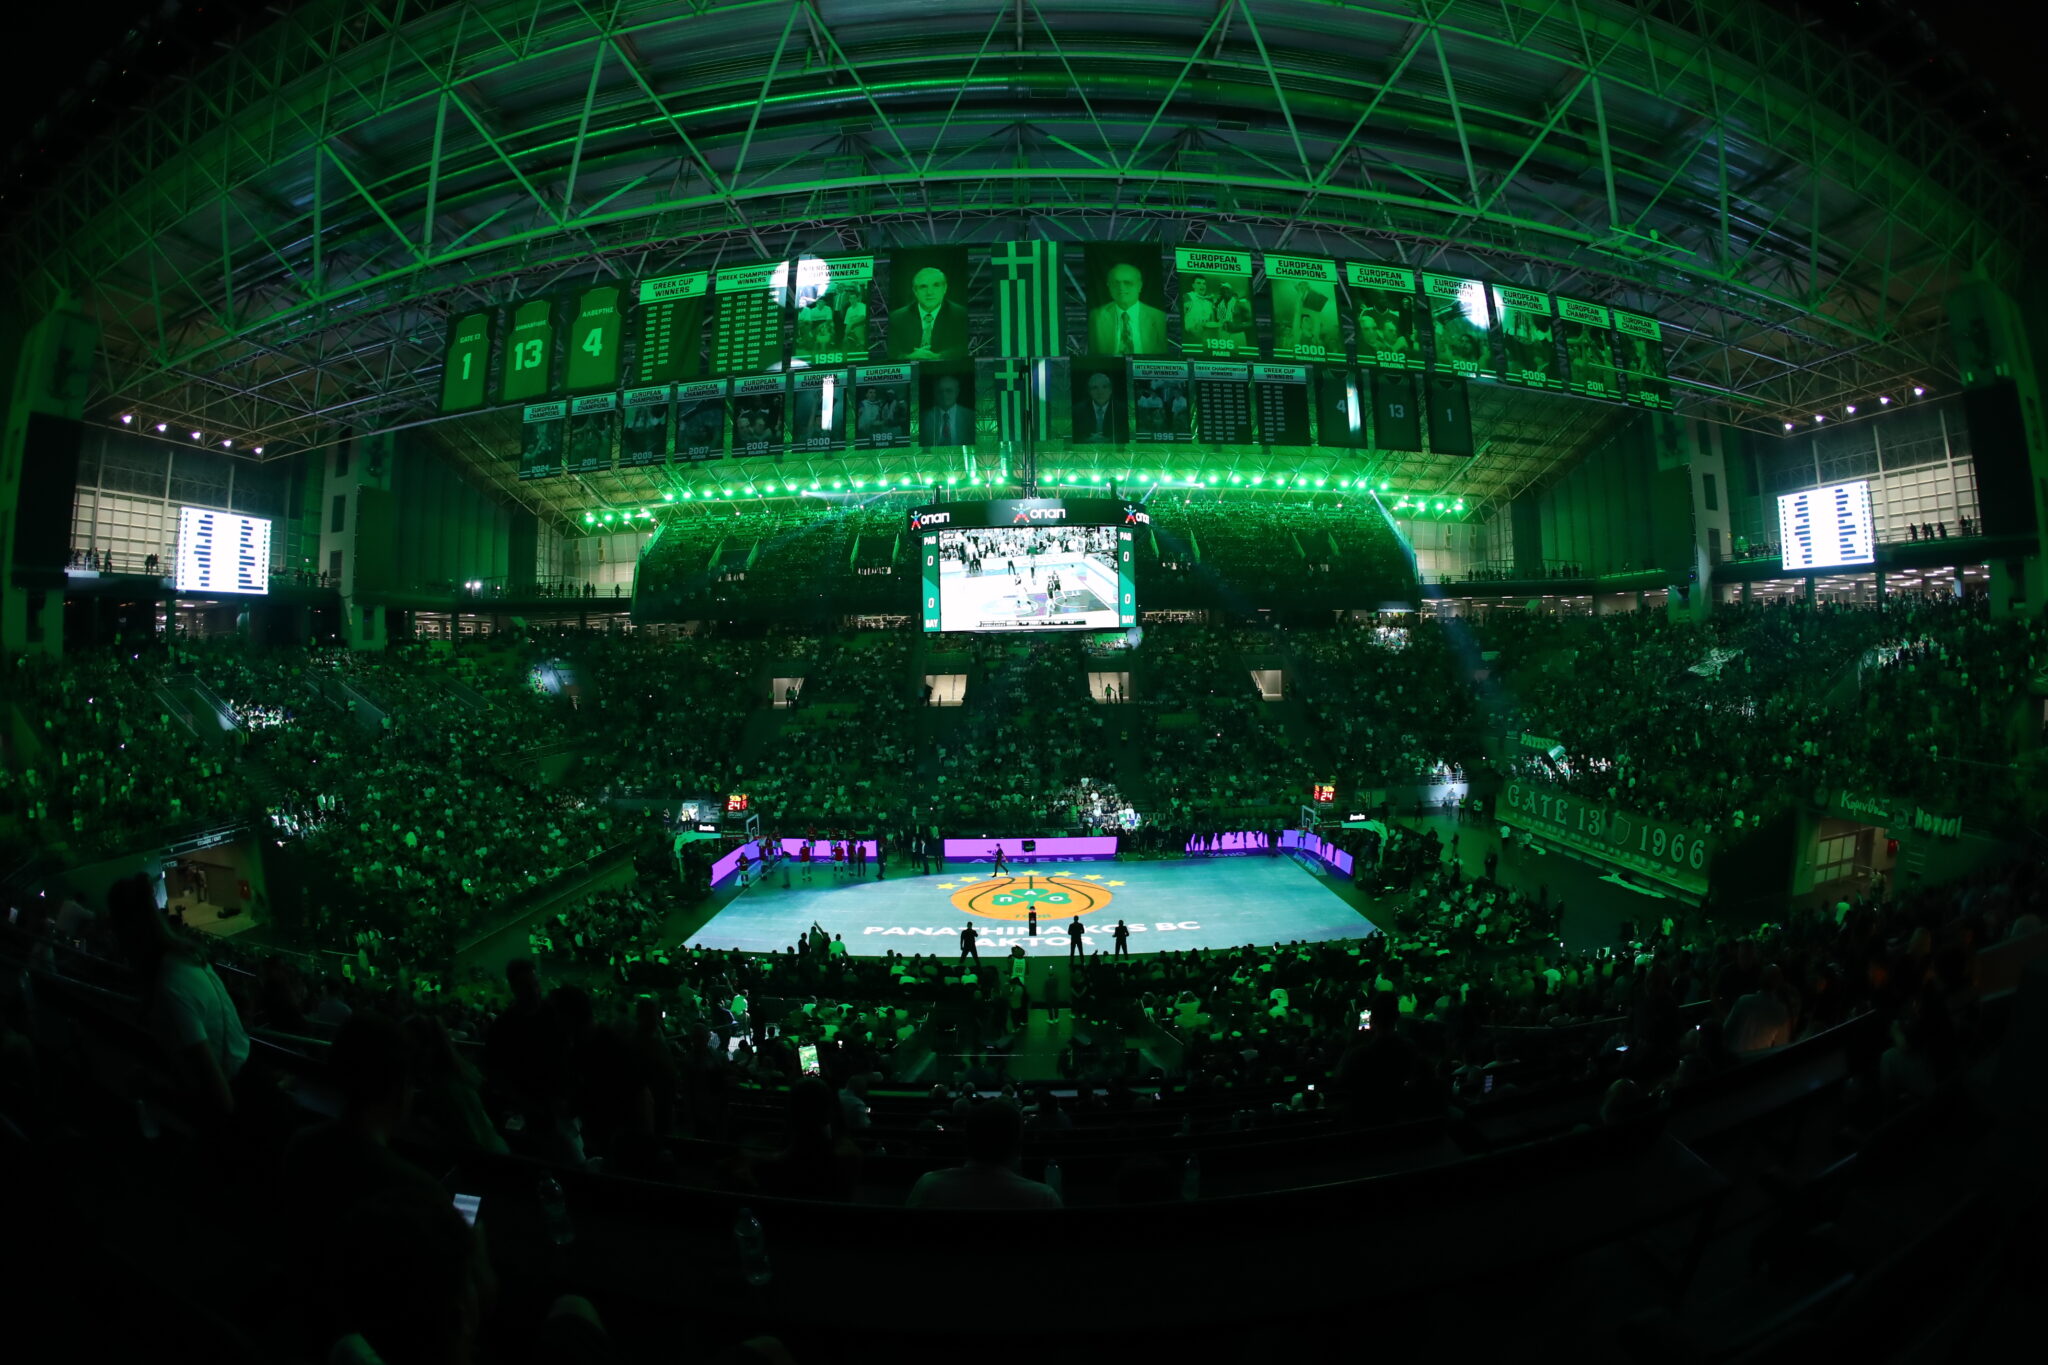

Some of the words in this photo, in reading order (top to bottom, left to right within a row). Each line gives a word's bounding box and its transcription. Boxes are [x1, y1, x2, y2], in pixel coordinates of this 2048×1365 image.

[1190, 253, 1238, 264] EUROPEAN
[1186, 260, 1241, 272] CHAMPIONS
[1278, 260, 1324, 271] EUROPEAN
[718, 274, 738, 282] GREEK
[825, 269, 859, 277] WINNERS
[1275, 267, 1327, 279] CHAMPIONS
[1359, 268, 1402, 279] EUROPEAN
[653, 281, 677, 290] GREEK
[678, 278, 694, 287] CUP
[737, 277, 766, 286] WINNERS
[1356, 275, 1406, 288] CHAMPIONS
[1434, 278, 1473, 291] EUROPEAN
[655, 286, 691, 297] WINNERS
[1503, 290, 1540, 303] EUROPEAN
[1502, 297, 1543, 311] CHAMPIONS
[1566, 303, 1599, 316] EUROPEAN
[1565, 308, 1603, 323] CHAMPIONS
[1622, 315, 1652, 329] EUROPEAN
[1621, 321, 1655, 336] CHAMPIONS
[582, 327, 604, 357] 4
[1206, 338, 1235, 350] 1996
[514, 339, 543, 370] 13
[1294, 344, 1325, 356] 2000
[815, 352, 843, 364] 1996
[1377, 351, 1406, 363] 2002
[462, 353, 472, 380] 1
[865, 367, 901, 377] EUROPEAN
[1452, 360, 1478, 372] 2007
[803, 374, 838, 382] EUROPEAN
[863, 373, 904, 382] CHAMPIONS
[1522, 370, 1546, 382] 2009
[686, 383, 718, 392] EUROPEAN
[741, 383, 779, 393] CHAMPIONS
[743, 378, 777, 388] EUROPEAN
[1587, 381, 1604, 392] 2011
[683, 389, 720, 398] CHAMPIONS
[1640, 391, 1660, 402] 2024
[1336, 400, 1346, 414] 4
[1389, 403, 1405, 418] 13
[1446, 408, 1453, 422] 1
[806, 437, 831, 447] 2000
[872, 432, 893, 441] 1996
[1153, 432, 1174, 441] 1996
[746, 442, 769, 450] 2002
[926, 554, 934, 566] 0
[1122, 550, 1130, 562] 0
[928, 597, 935, 609] 0
[1124, 593, 1131, 604] 0
[1320, 792, 1333, 801] 24
[728, 801, 740, 810] 24
[1506, 784, 1569, 826] GATE
[1577, 806, 1601, 836] 13
[1639, 823, 1705, 870] 1966
[864, 923, 1148, 936] PANATHINAKOS
[1155, 920, 1201, 931] BC
